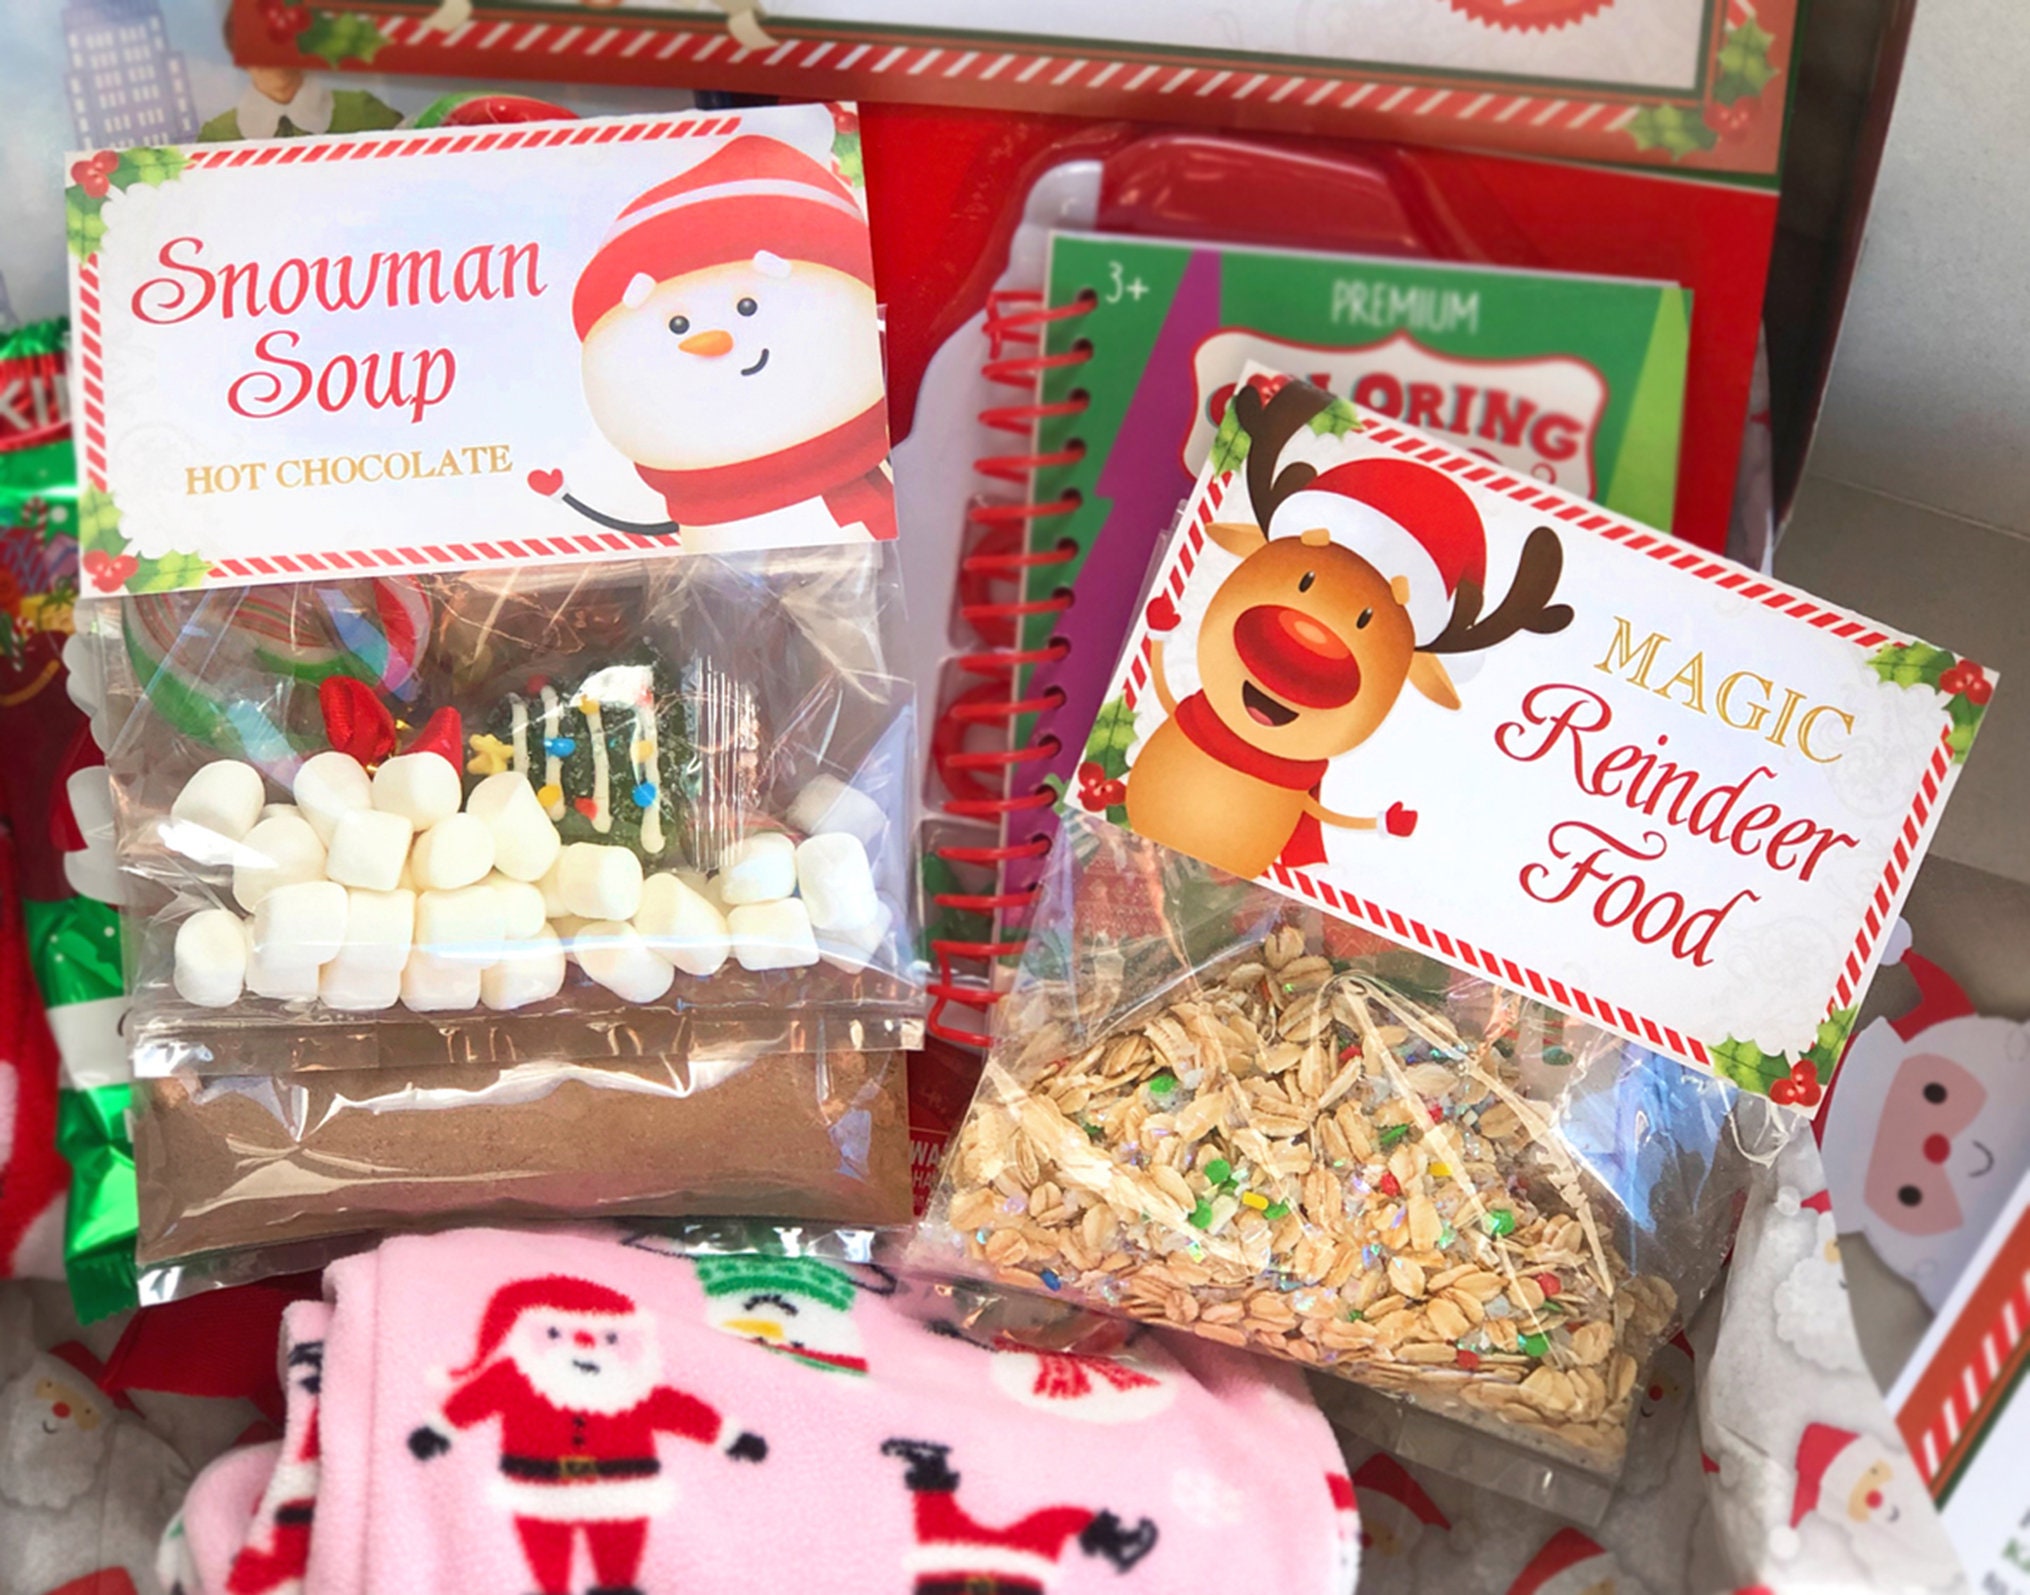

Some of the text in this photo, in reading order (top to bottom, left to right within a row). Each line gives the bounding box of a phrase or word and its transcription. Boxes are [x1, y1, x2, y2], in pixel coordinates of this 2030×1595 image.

[131, 236, 547, 325] Snowman
[1105, 259, 1150, 304] 3+
[1330, 277, 1481, 335] PREMIUM
[227, 329, 457, 424] Soup
[1205, 372, 1586, 462] ORING
[185, 443, 513, 496] HOT CHOCOLATE
[1593, 615, 1855, 764] MAGIC
[1494, 682, 1860, 882] Reindeer
[1518, 820, 1763, 968] Food
